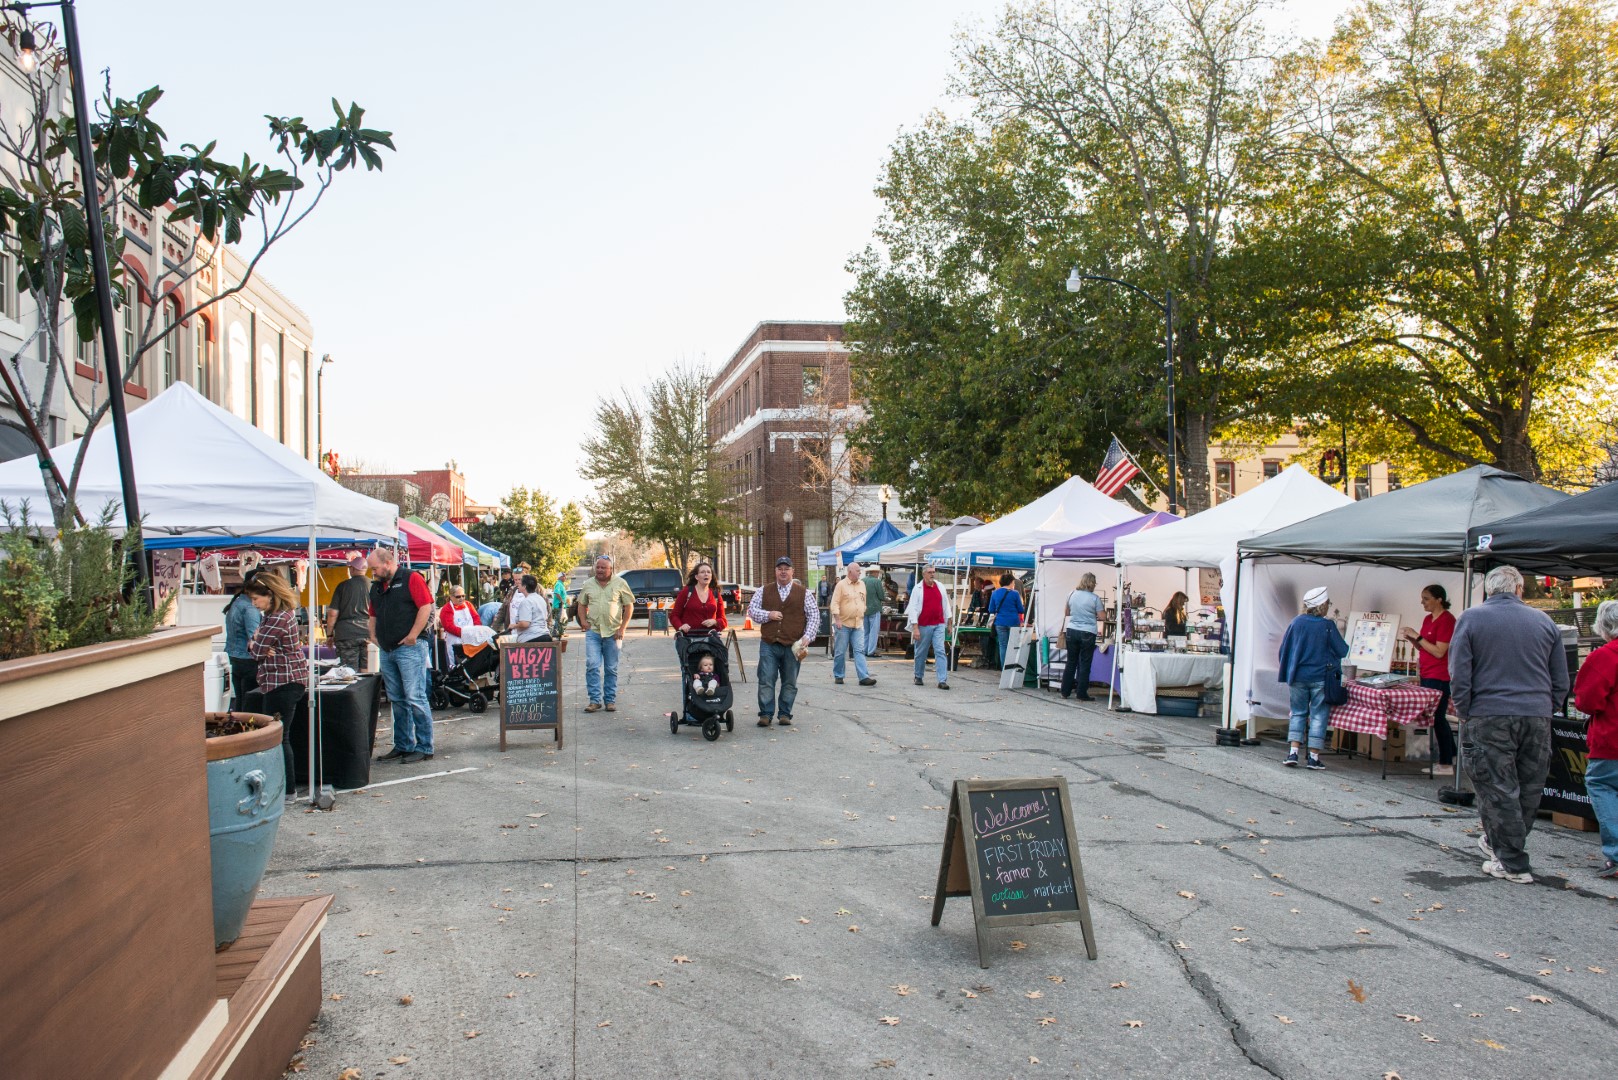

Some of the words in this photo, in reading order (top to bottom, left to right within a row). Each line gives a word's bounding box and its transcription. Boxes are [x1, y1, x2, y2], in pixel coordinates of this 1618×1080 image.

[507, 647, 552, 665] WAGYU
[512, 664, 550, 679] BEEF
[511, 704, 528, 714] 20%
[529, 702, 545, 713] OFF
[1541, 787, 1561, 798] 00%
[975, 790, 1050, 834] Welcome!
[1000, 833, 1011, 842] to
[1016, 829, 1036, 840] the
[984, 843, 1024, 866] FIRST
[1028, 838, 1067, 861] FRIDAY
[1037, 861, 1048, 879] &
[1033, 877, 1073, 897] market!
